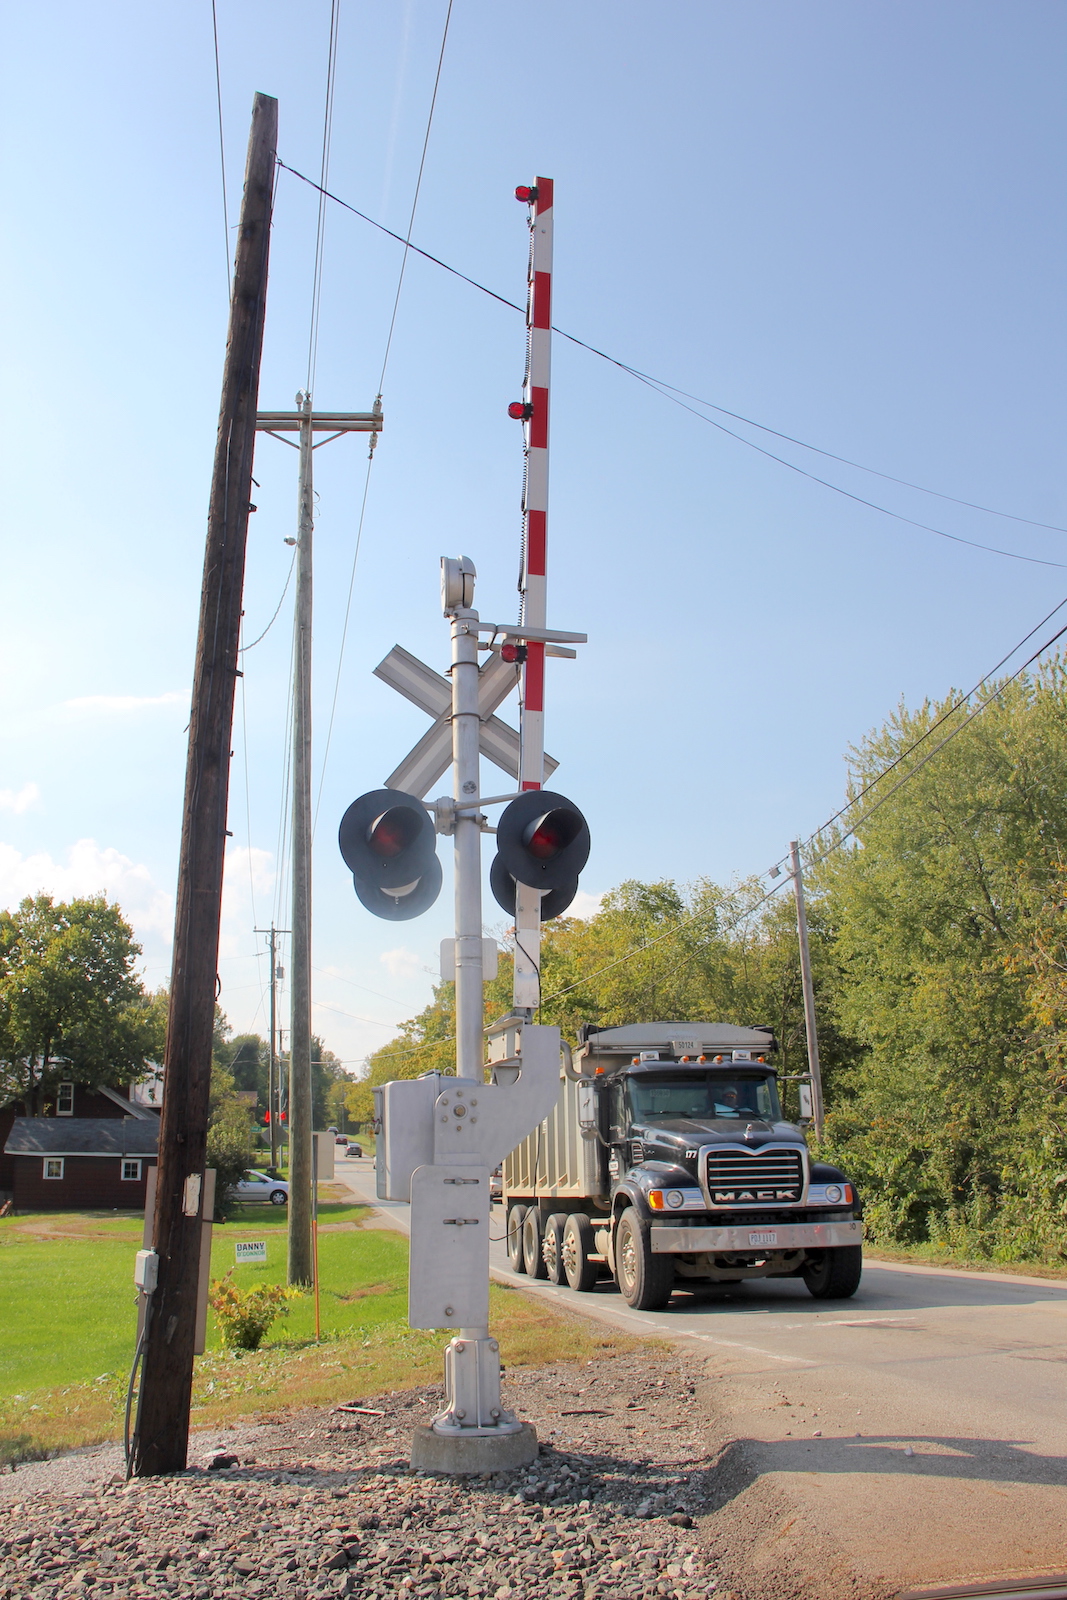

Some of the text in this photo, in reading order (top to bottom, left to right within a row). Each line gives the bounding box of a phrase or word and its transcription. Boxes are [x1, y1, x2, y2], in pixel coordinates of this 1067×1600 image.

[678, 1041, 694, 1049] 50124
[685, 1150, 698, 1159] 177
[715, 1190, 797, 1201] MACK
[236, 1243, 264, 1251] DANNY
